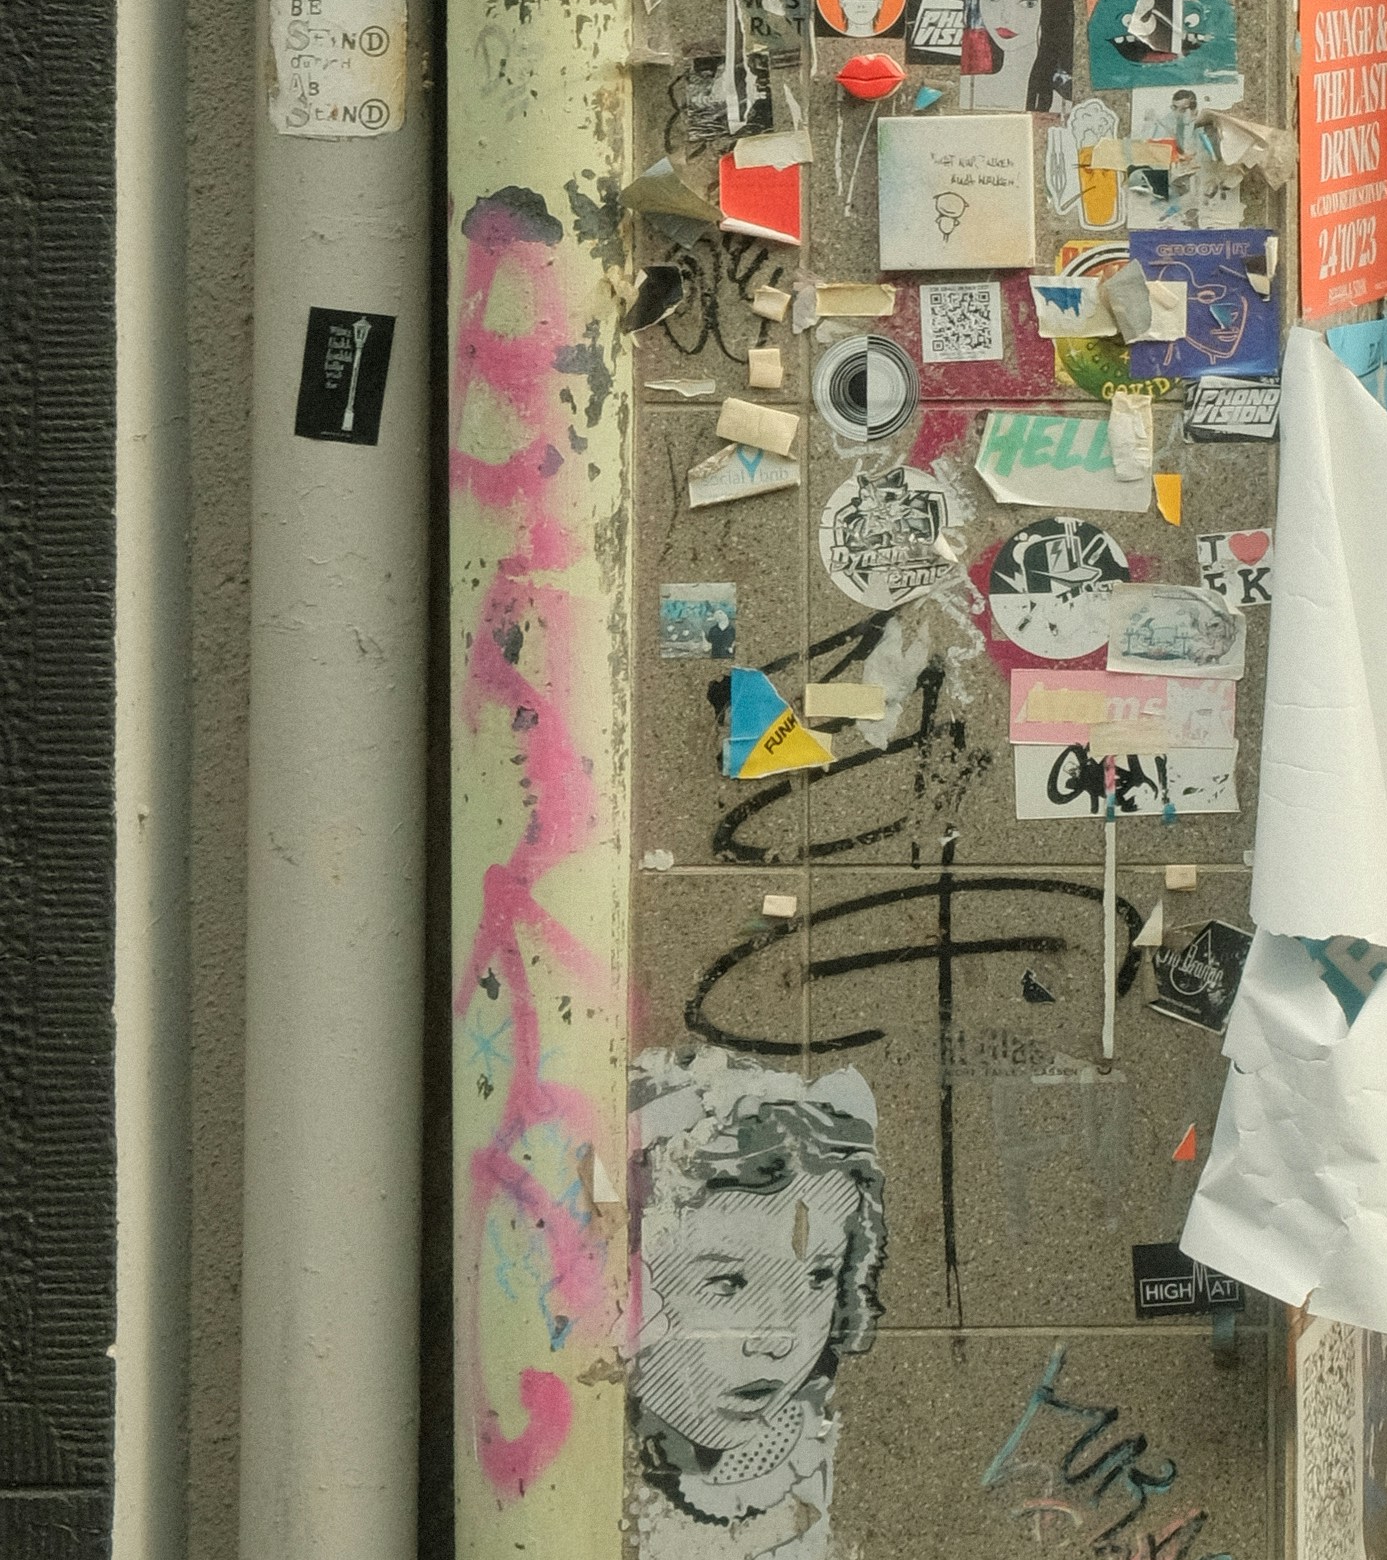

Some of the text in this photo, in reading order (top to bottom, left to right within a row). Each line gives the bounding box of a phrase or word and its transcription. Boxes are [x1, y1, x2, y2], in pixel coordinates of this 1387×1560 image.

[1320, 121, 1380, 183] DRINKS
[1202, 388, 1278, 408] PHONO
[1195, 403, 1274, 425] VISION
